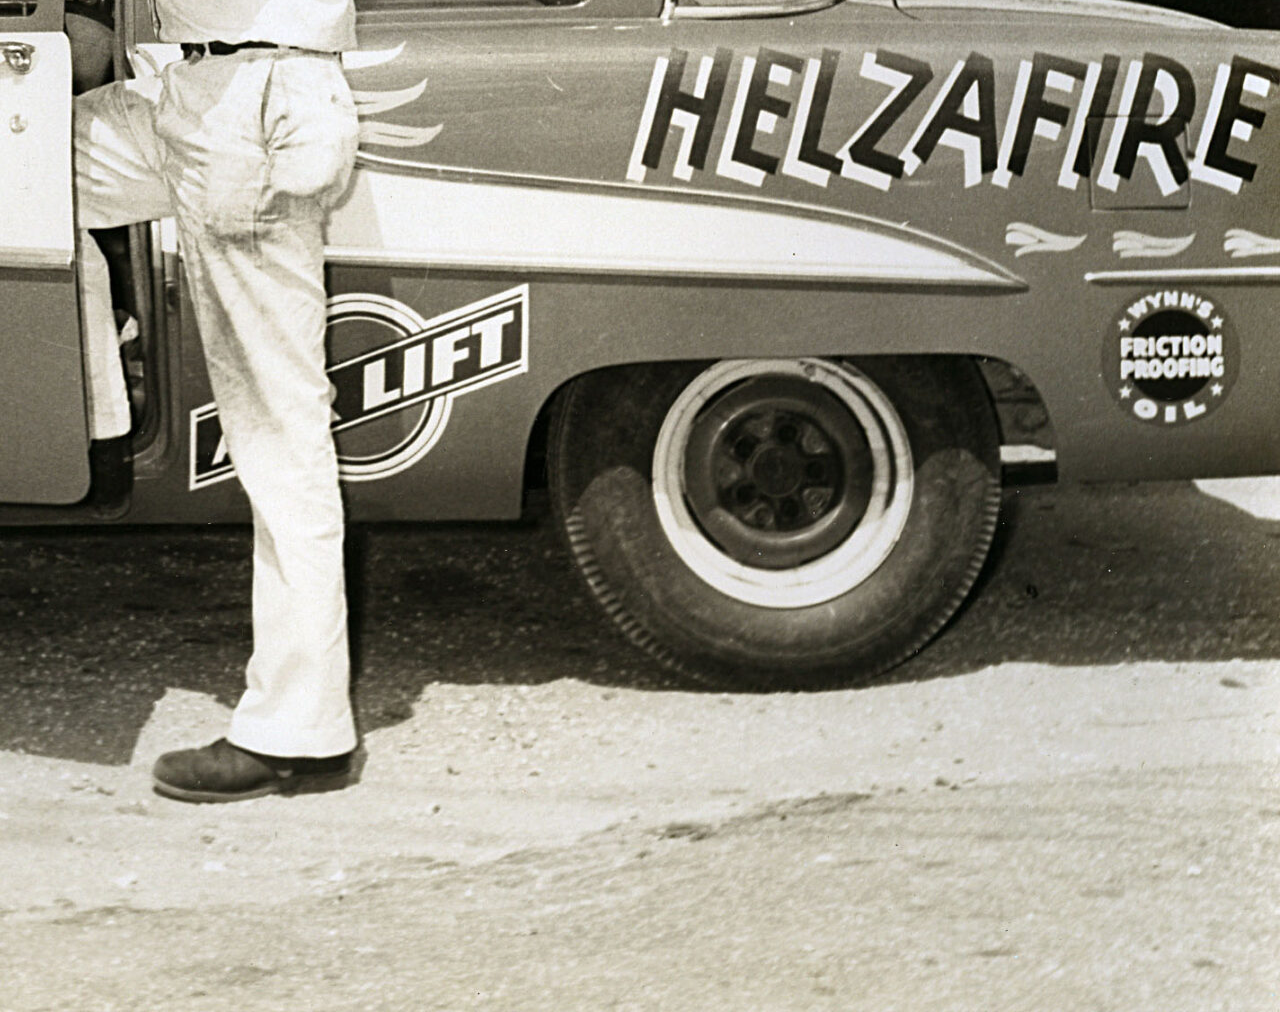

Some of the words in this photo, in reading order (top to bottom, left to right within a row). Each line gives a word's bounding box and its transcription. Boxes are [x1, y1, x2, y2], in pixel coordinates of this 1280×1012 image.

[625, 45, 1280, 196] HELZAFIRE
[1127, 290, 1214, 319] WYNN'S
[1120, 334, 1222, 358] FRICTION
[363, 309, 514, 411] LIFT
[1120, 356, 1224, 380] PROOFING
[1133, 398, 1207, 423] OIL
